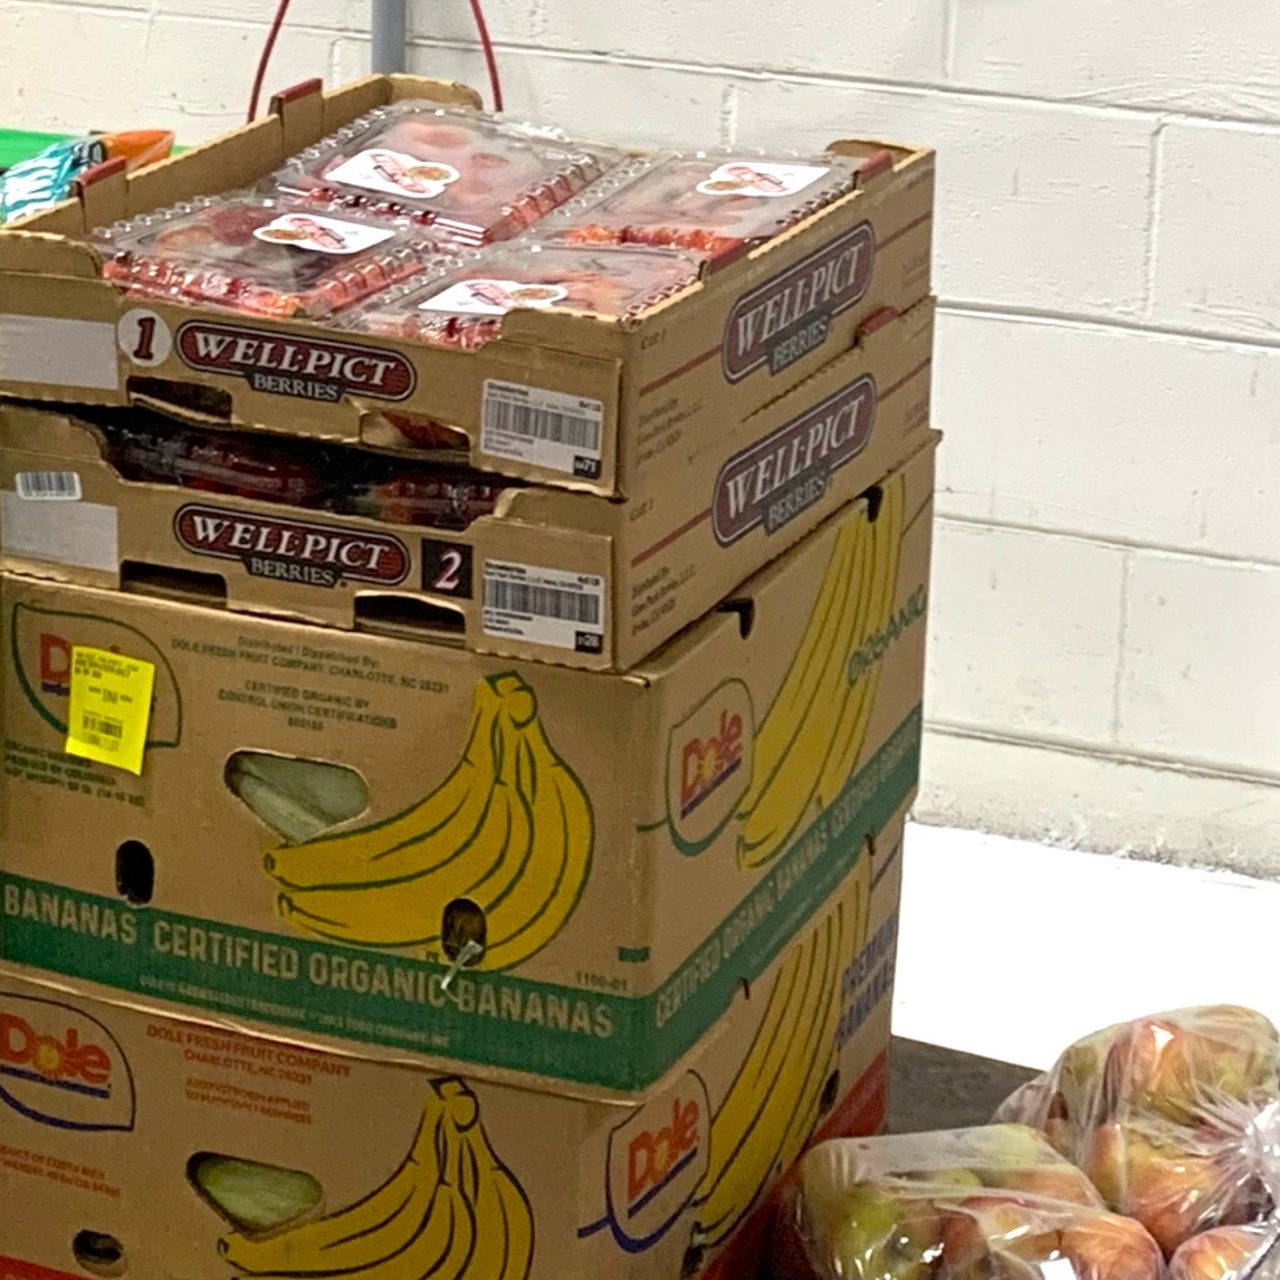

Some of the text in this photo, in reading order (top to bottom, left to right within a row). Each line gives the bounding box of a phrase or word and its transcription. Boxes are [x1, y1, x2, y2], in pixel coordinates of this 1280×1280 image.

[132, 316, 157, 361] 1
[771, 315, 829, 372] BERRIES
[253, 374, 339, 401] BERRIES
[768, 468, 826, 531] BERRIES
[250, 557, 335, 587] BERRIES
[434, 550, 463, 591] 2
[170, 638, 200, 654] DOLE
[239, 650, 271, 665] FRUIT
[301, 688, 353, 708] ORGANIC
[681, 709, 743, 806] Dole
[3, 884, 138, 946] BANANAS
[153, 919, 300, 981] CERTIFIED
[308, 951, 447, 1009] ORGANIC
[457, 981, 614, 1039] BANANAS
[146, 1023, 352, 1078] DOLE FRESH FRUIT COMPANY
[627, 1096, 700, 1204] Dole
